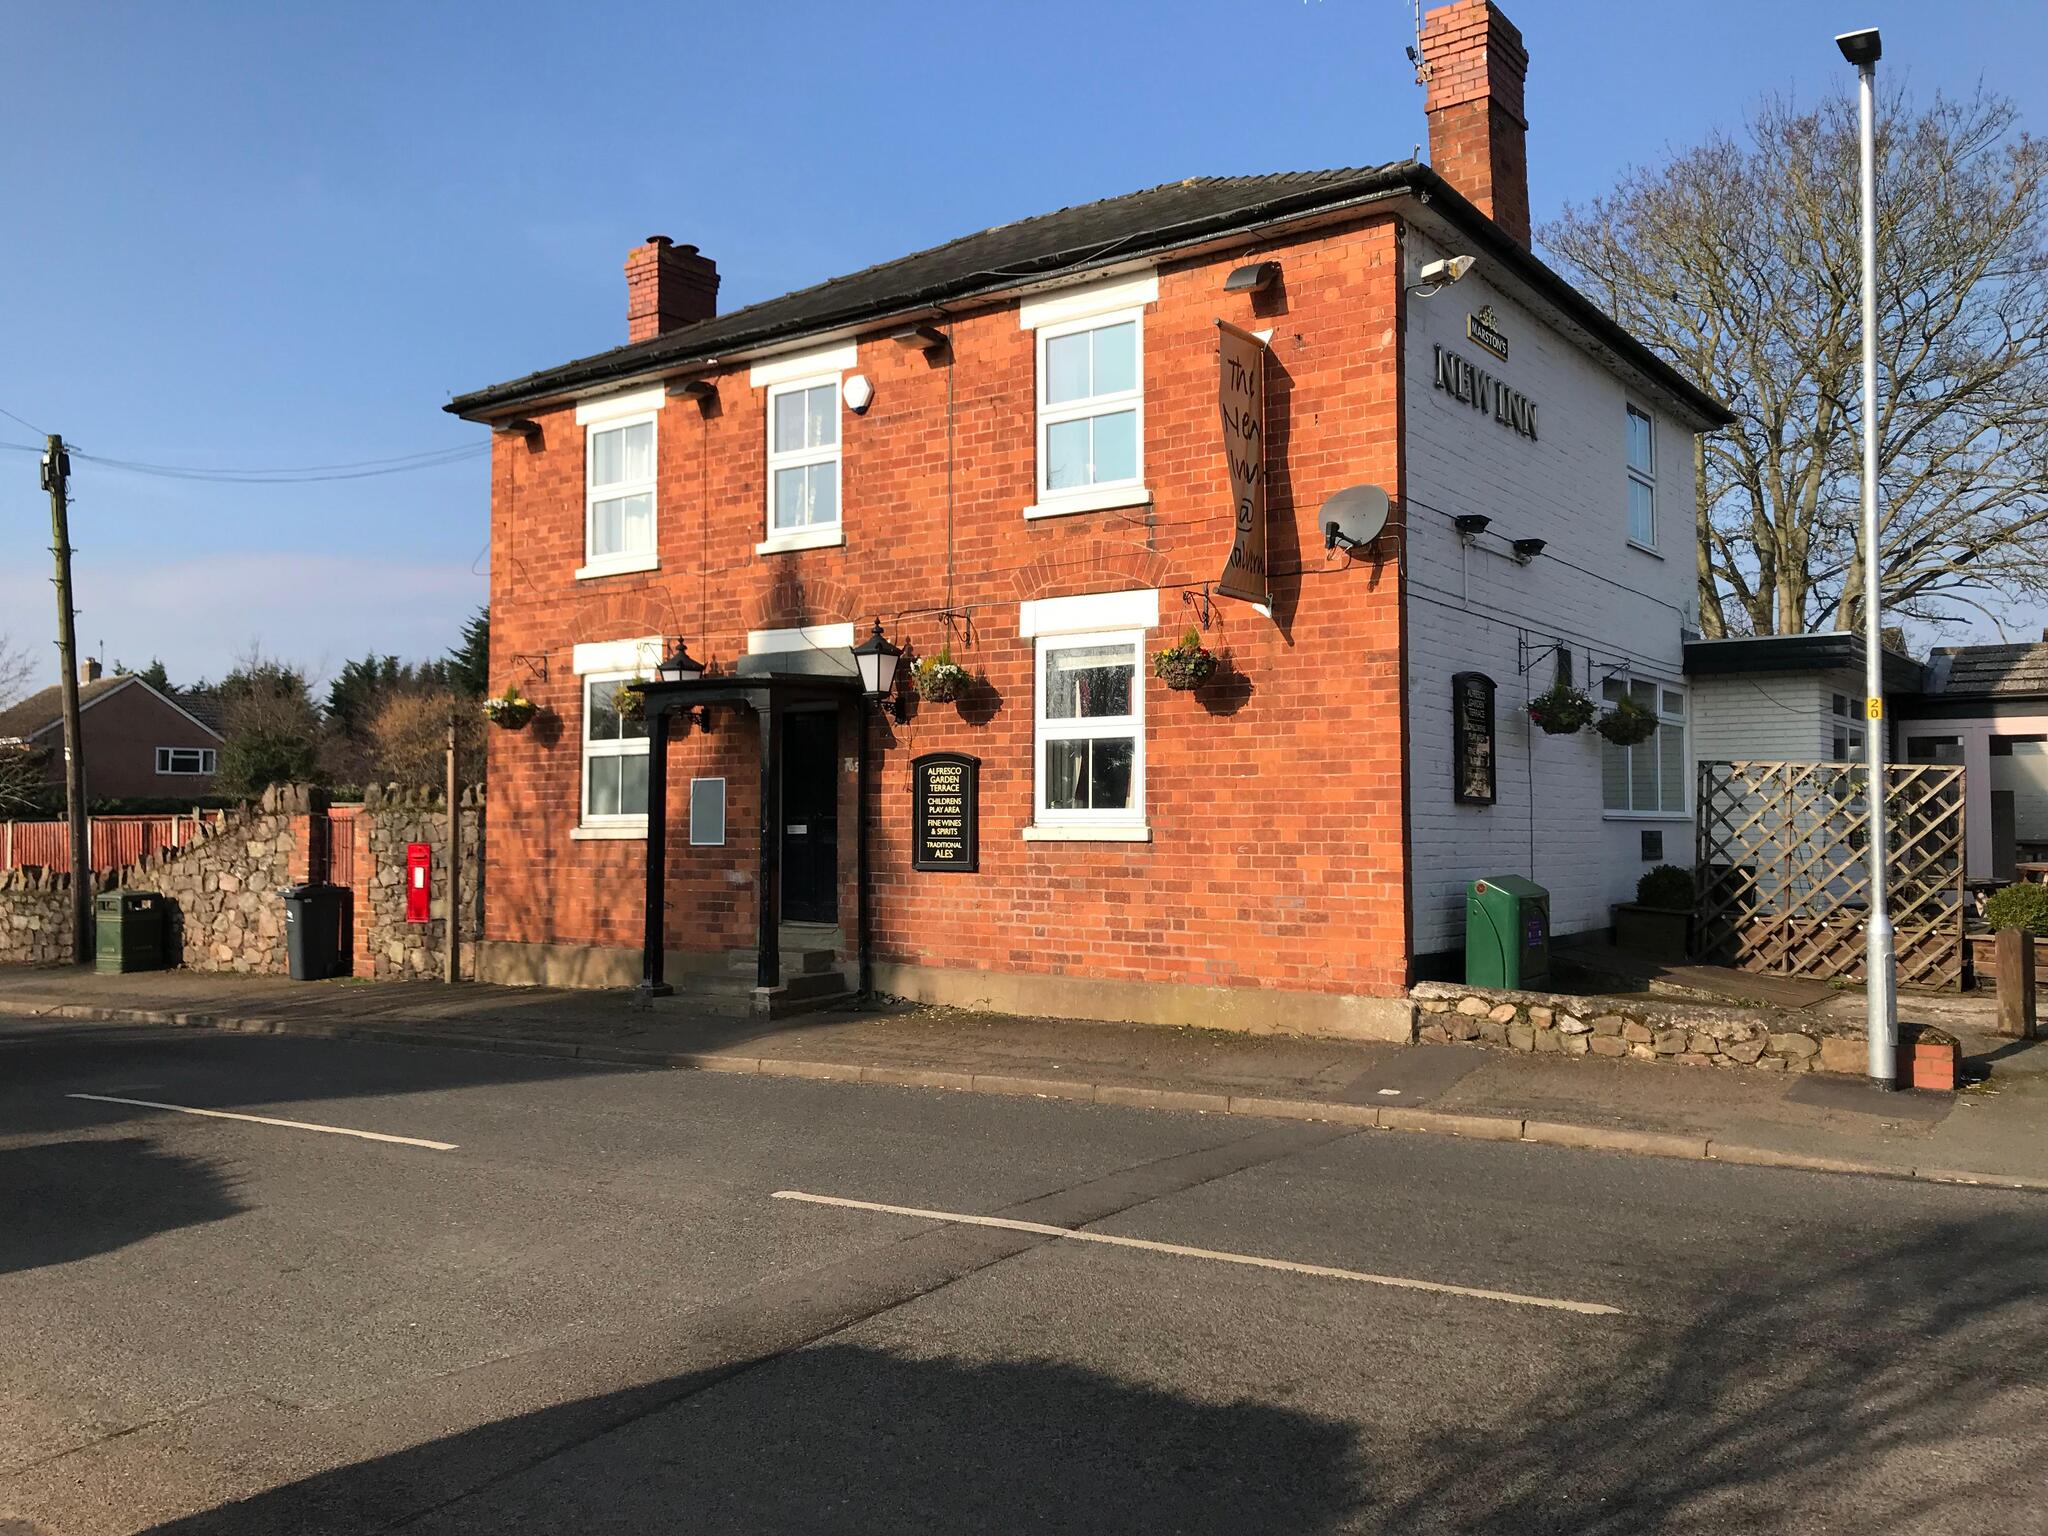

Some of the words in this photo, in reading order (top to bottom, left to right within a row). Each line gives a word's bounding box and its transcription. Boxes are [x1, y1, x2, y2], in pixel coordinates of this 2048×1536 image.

[1471, 321, 1507, 354] MARSTON'S
[1227, 356, 1255, 399] The
[1434, 343, 1496, 415] NEW
[1496, 379, 1538, 442] INN
[1236, 498, 1255, 533] @
[928, 767, 962, 775] ALFRESCO
[930, 776, 960, 784] GARDEN
[929, 784, 960, 792] TERRACE
[934, 850, 954, 859] ALES
